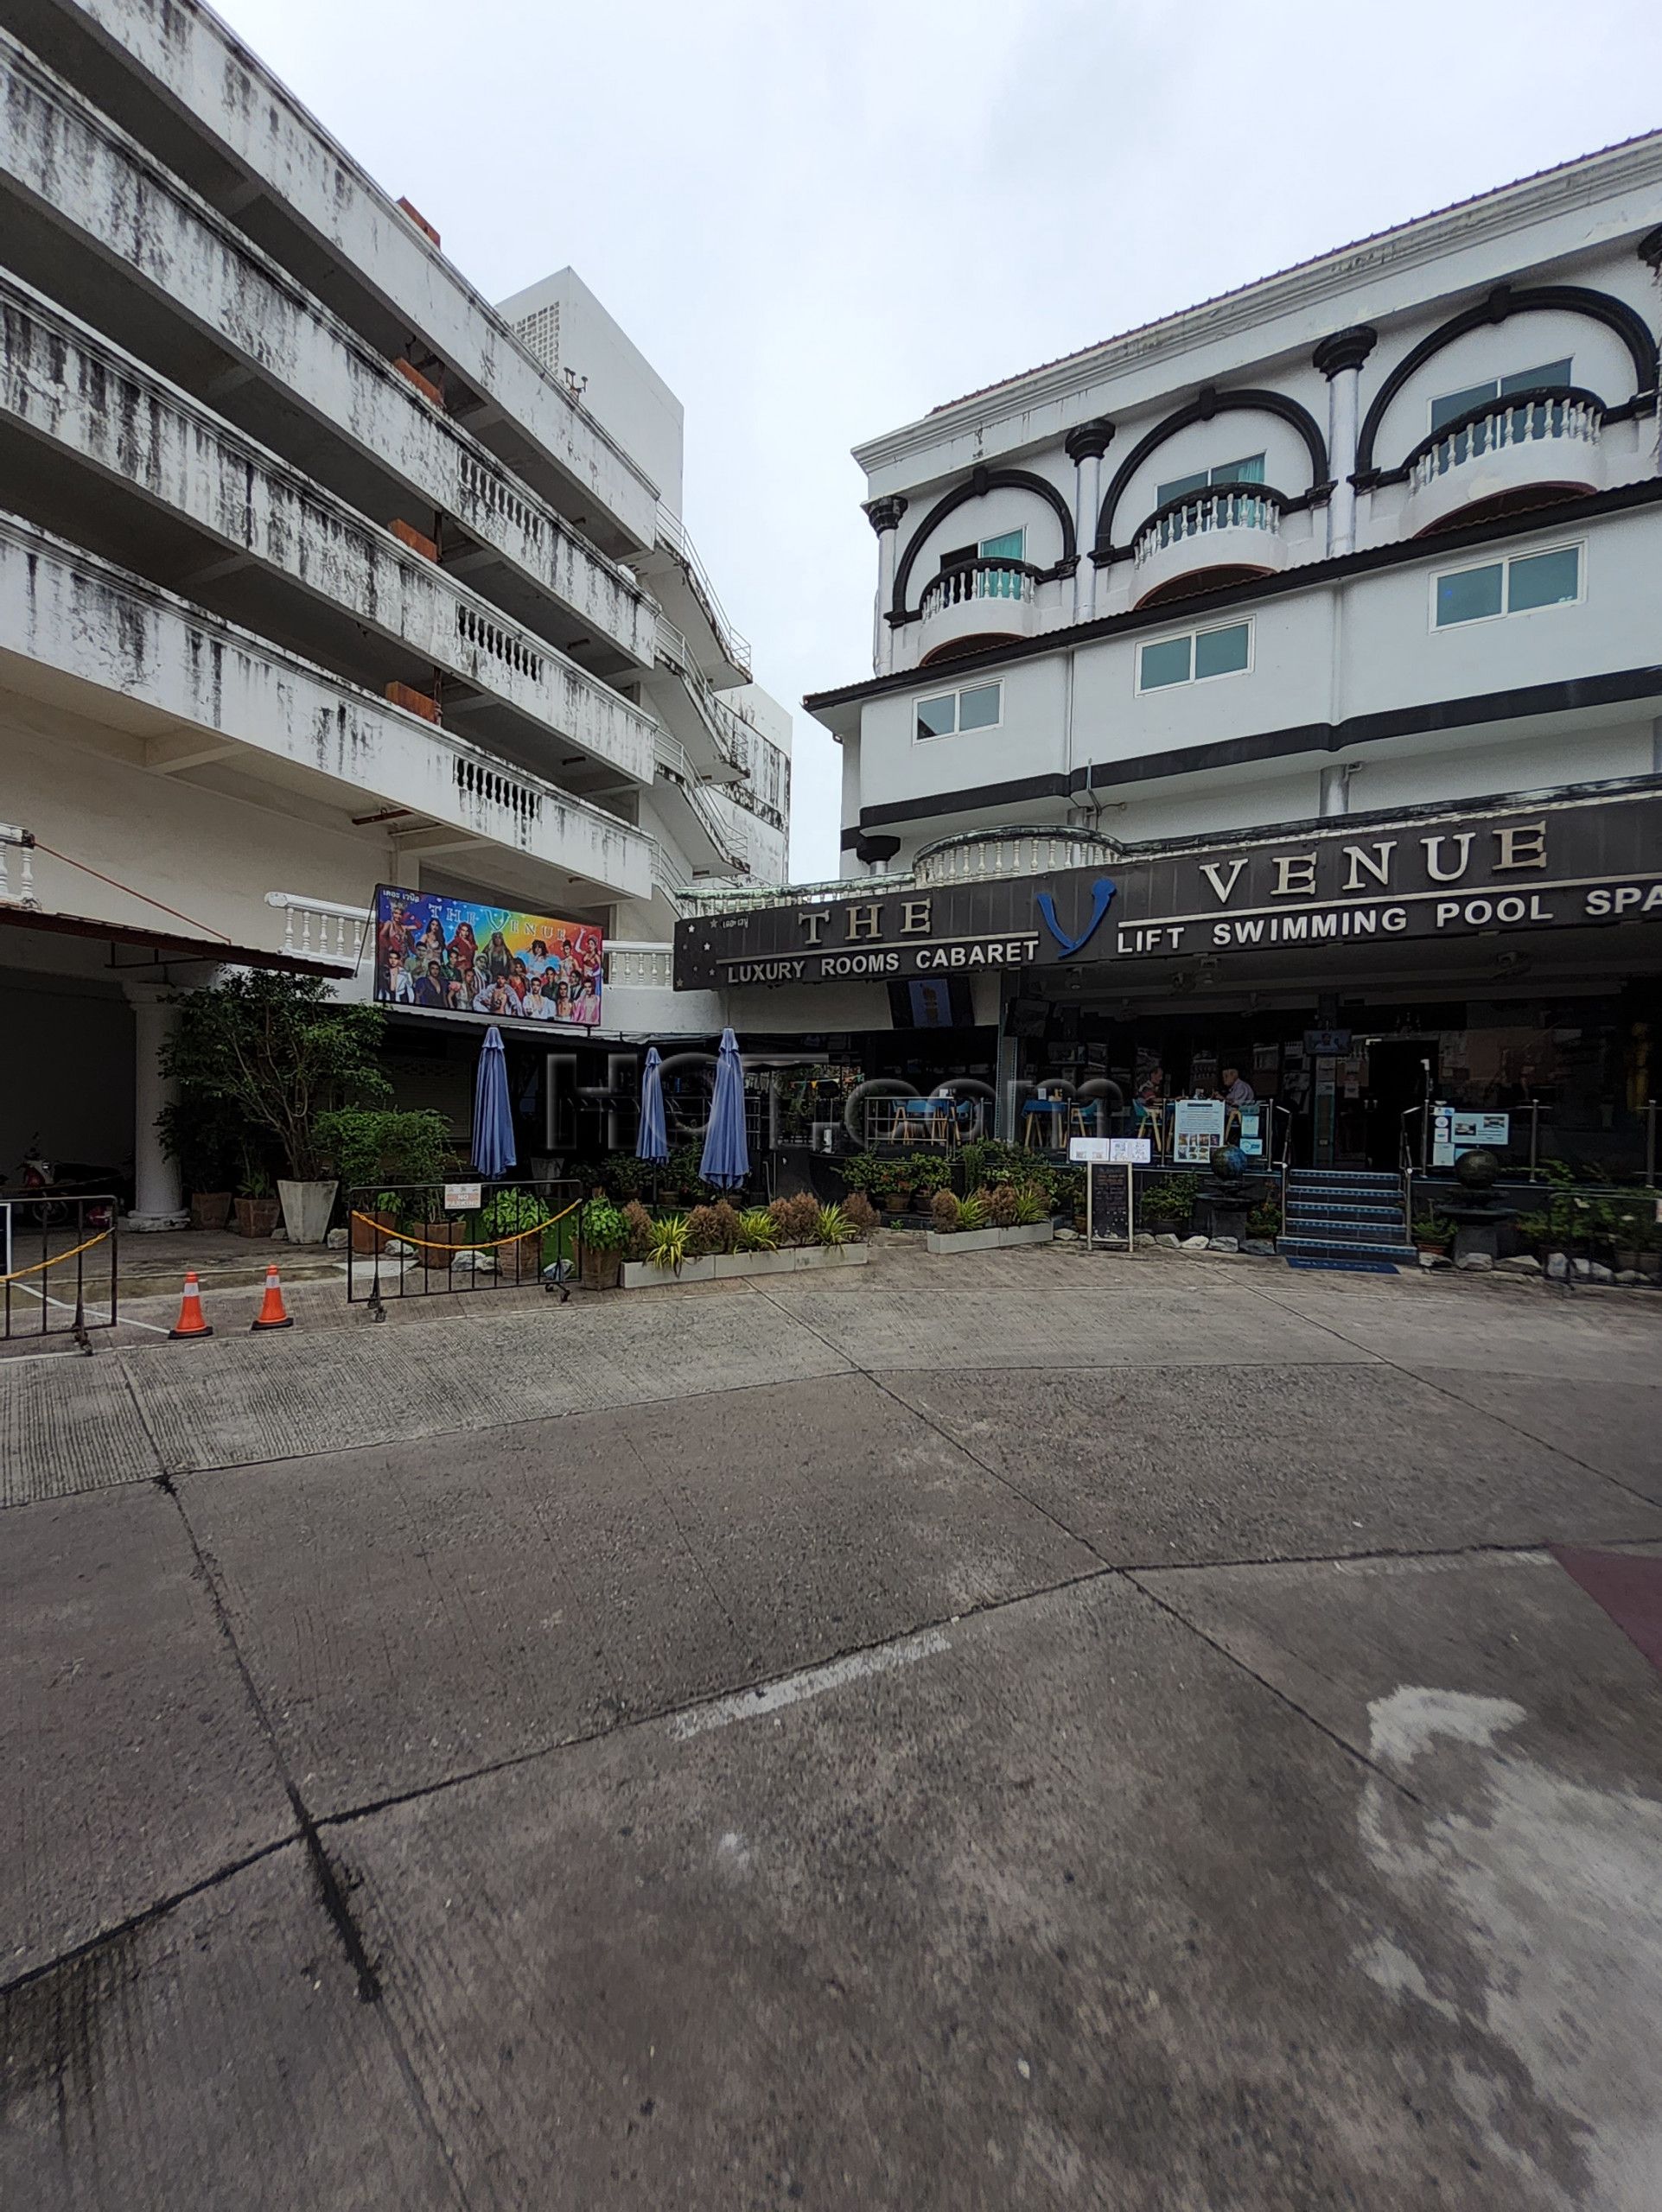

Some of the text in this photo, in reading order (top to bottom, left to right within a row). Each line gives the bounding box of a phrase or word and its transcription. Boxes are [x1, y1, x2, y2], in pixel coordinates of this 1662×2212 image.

[799, 820, 1548, 945] THE VENUE
[1118, 884, 1662, 953] LIFT SWIMMING POOL SPA
[728, 940, 1039, 983] LUXURY ROOMS CABARET
